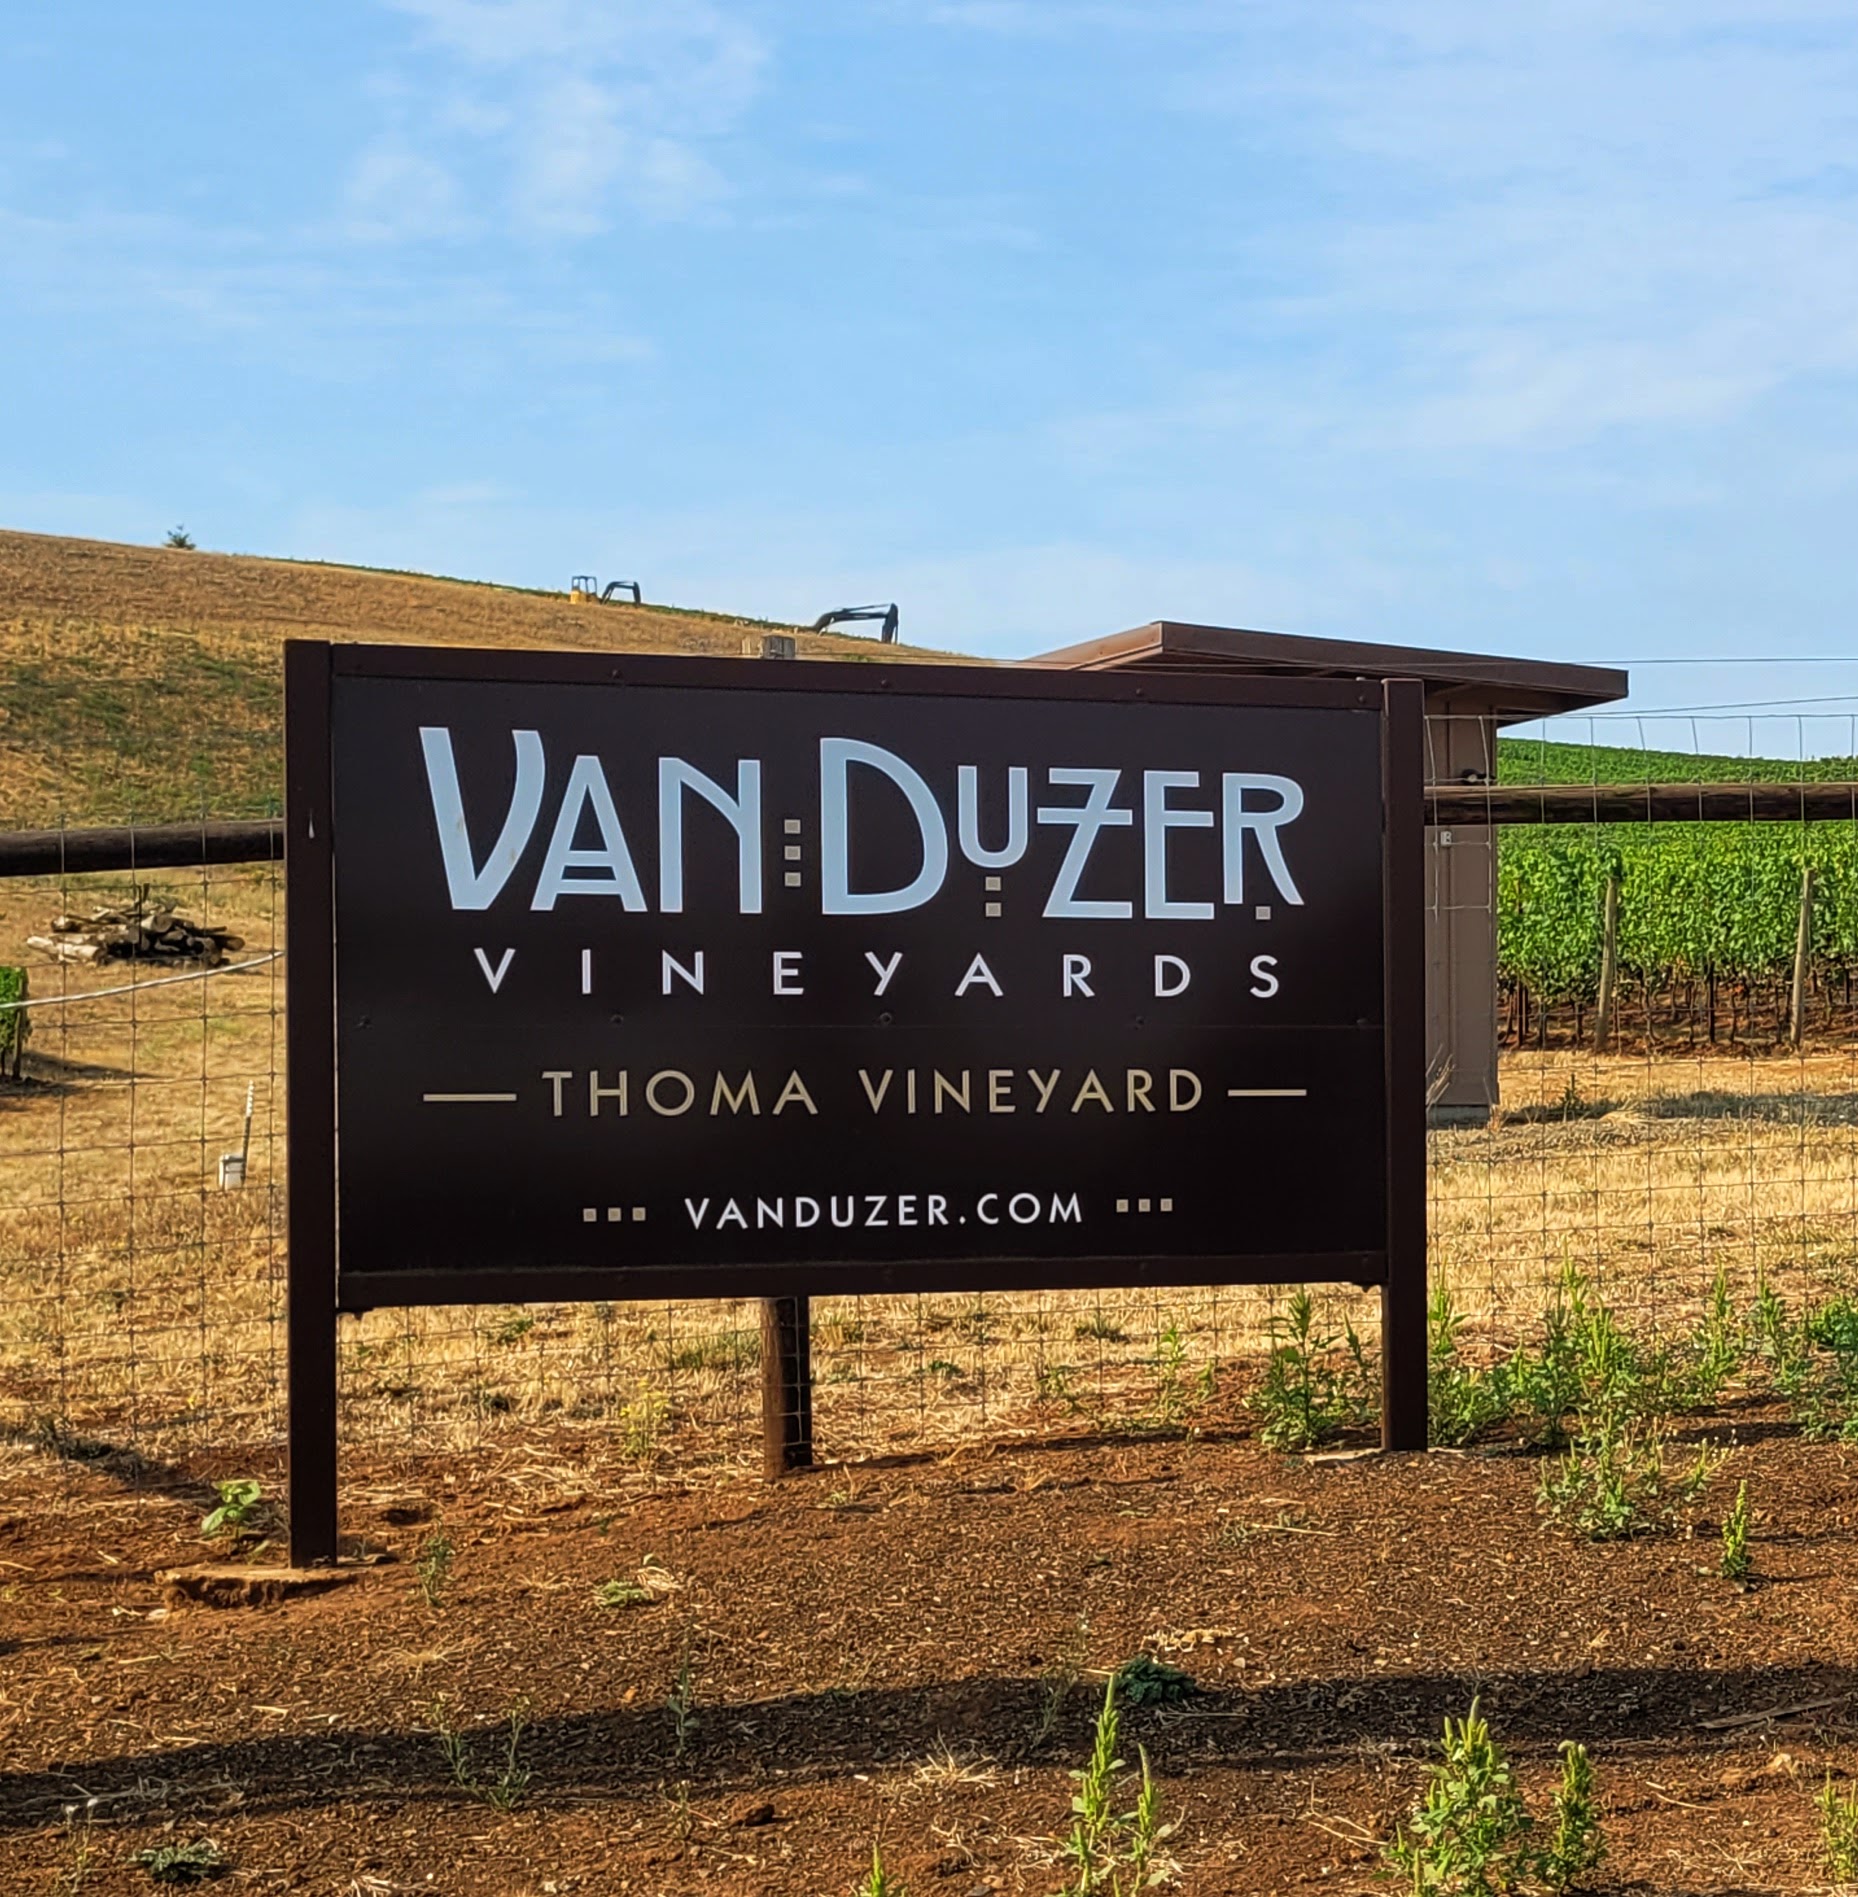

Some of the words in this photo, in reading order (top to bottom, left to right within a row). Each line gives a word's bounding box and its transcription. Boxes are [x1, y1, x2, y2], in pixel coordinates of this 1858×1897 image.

[418, 727, 763, 913] VAN
[820, 738, 1305, 919] DUZER
[474, 948, 1279, 998] VINEYARDS
[542, 1071, 818, 1116] THOMA
[858, 1069, 1202, 1114] VINEYARD
[684, 1193, 1082, 1230] VANDUZER.COM
